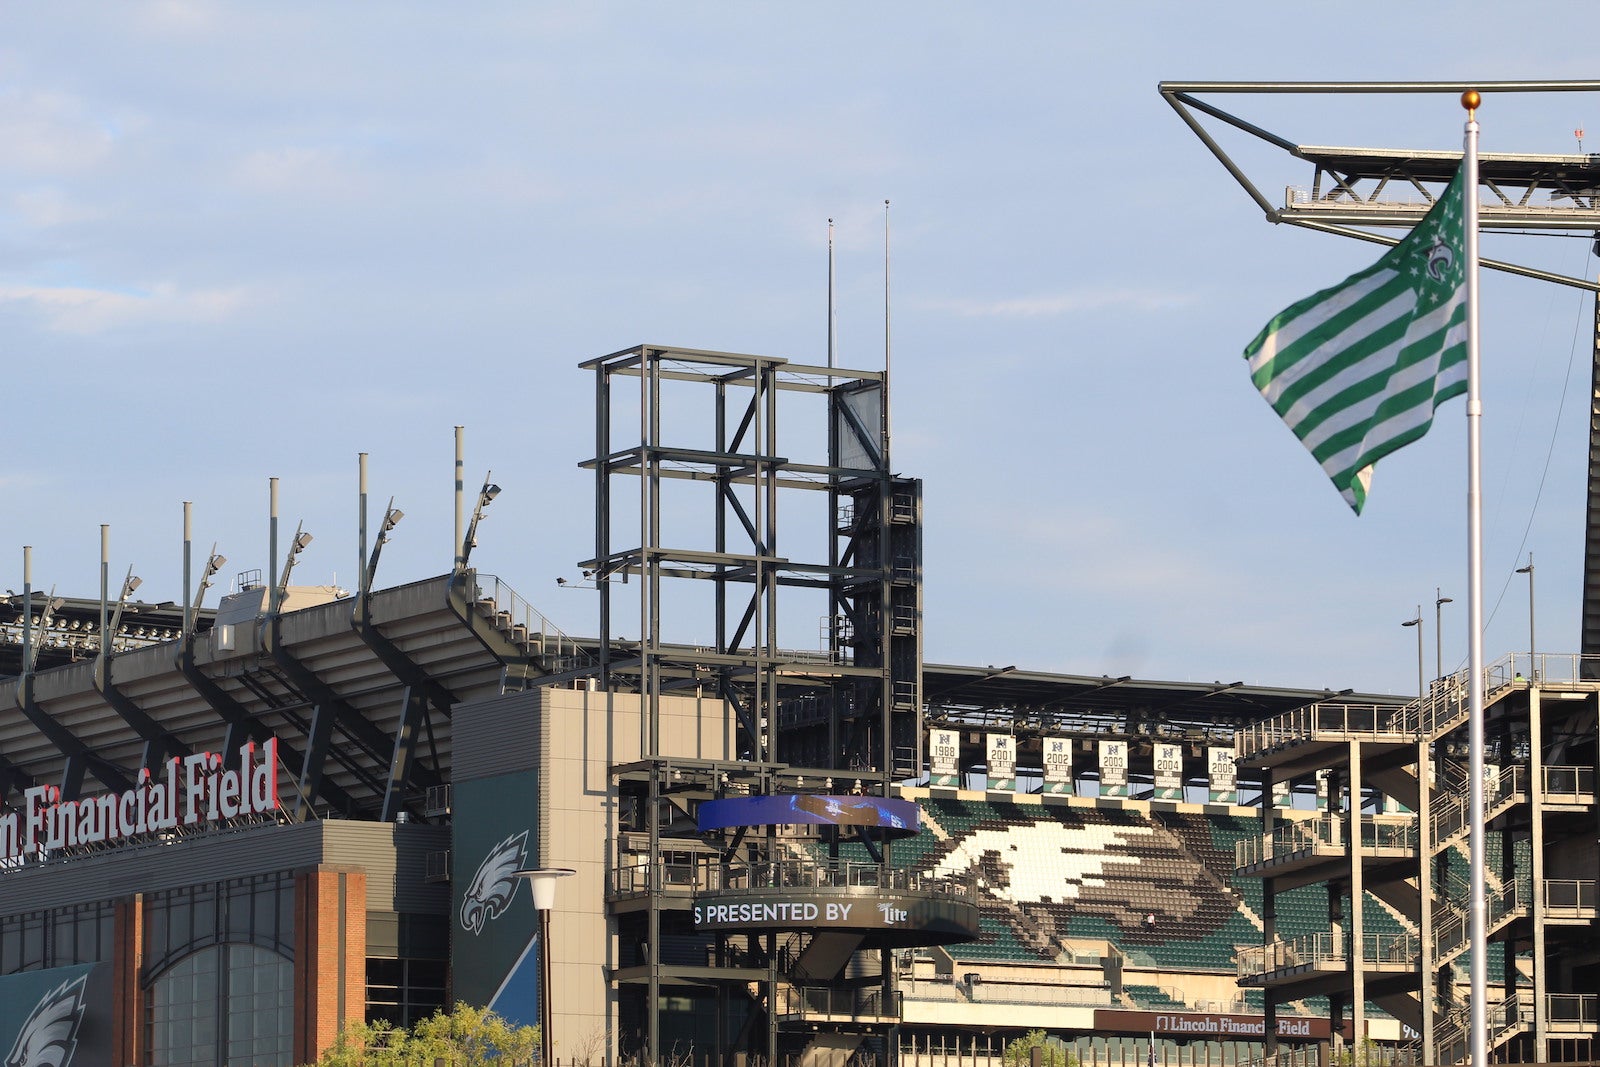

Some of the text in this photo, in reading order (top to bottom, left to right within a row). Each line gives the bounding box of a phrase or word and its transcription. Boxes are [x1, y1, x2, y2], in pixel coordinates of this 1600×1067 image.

[935, 745, 955, 757] 1988
[991, 749, 1013, 761] 2001
[1046, 753, 1069, 764] 2002
[1103, 756, 1123, 767] 2003
[1157, 760, 1179, 770] 2004
[1212, 763, 1233, 773] 2006
[24, 756, 180, 853] Financial
[184, 737, 279, 825] Field
[707, 902, 819, 924] PRESENTED
[826, 903, 852, 922] BY
[880, 906, 908, 925] Lite
[1171, 1016, 1310, 1036] Lincoln Financi Field
